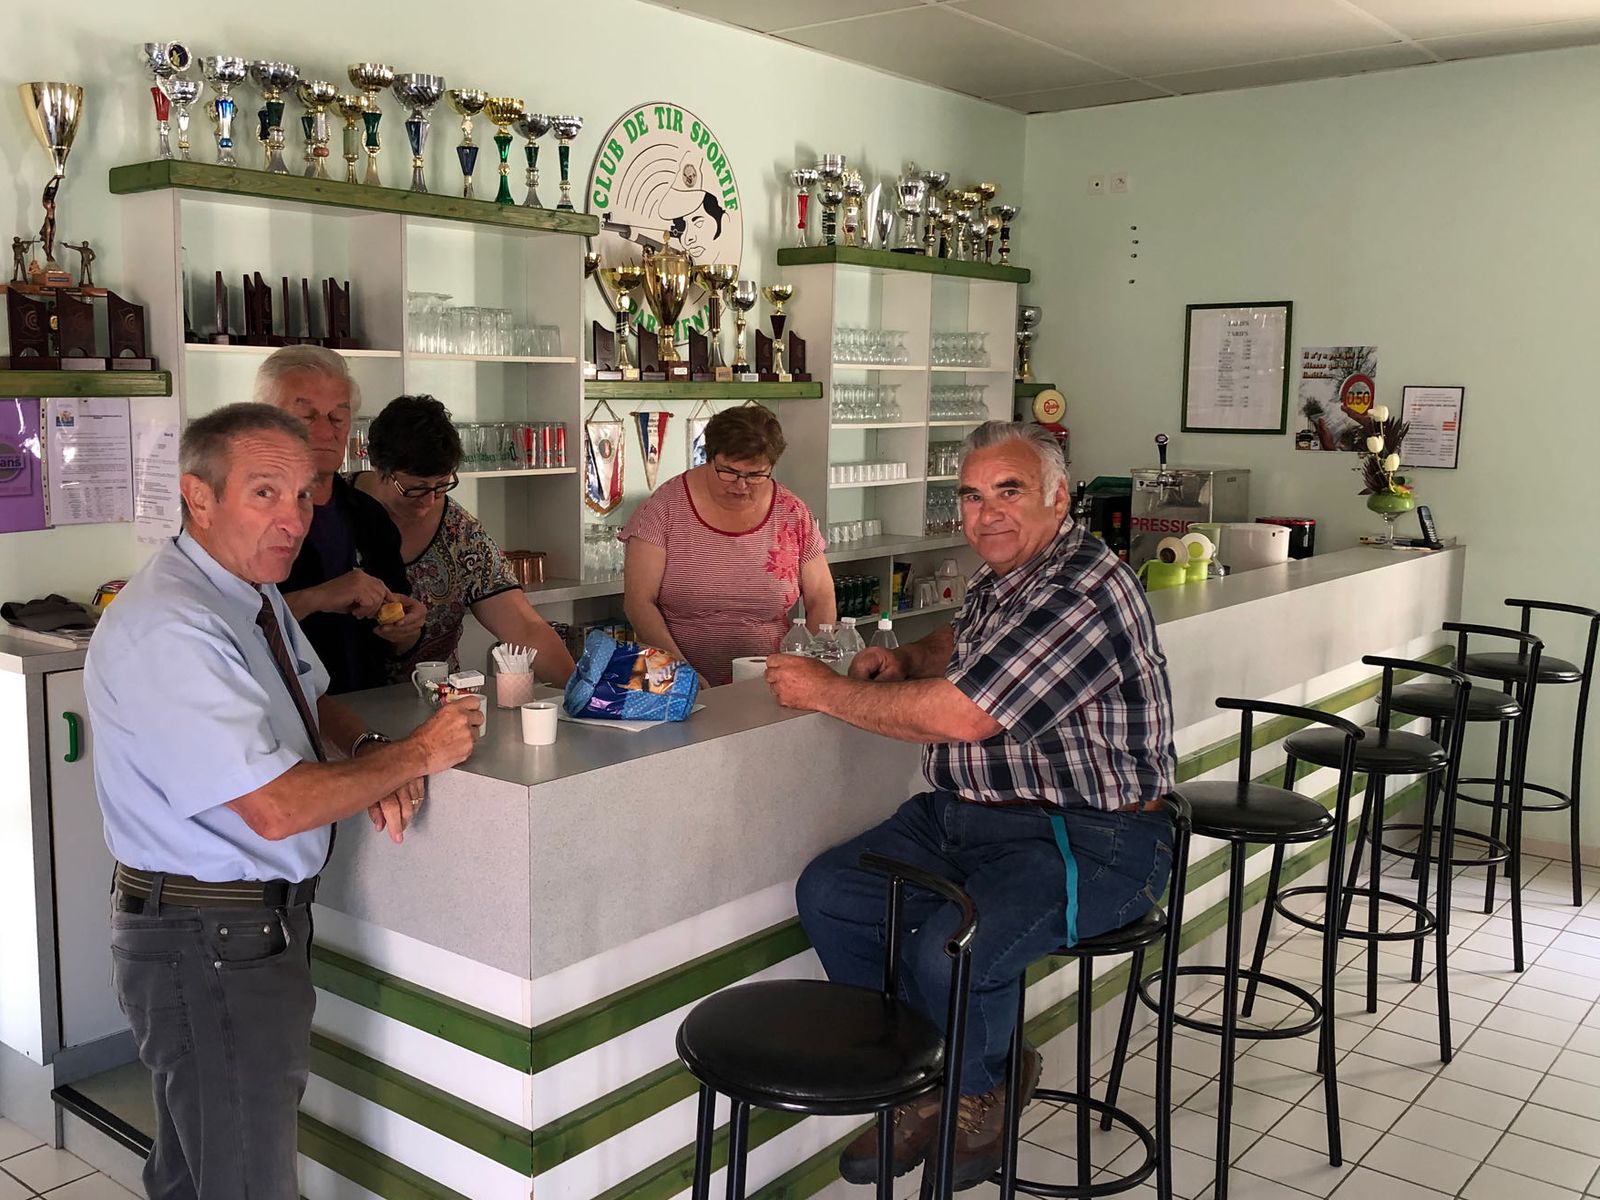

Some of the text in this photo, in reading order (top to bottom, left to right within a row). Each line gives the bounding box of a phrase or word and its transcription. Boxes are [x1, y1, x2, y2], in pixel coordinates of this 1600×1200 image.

[593, 106, 739, 211] CLUB DE TIR SPORTIF
